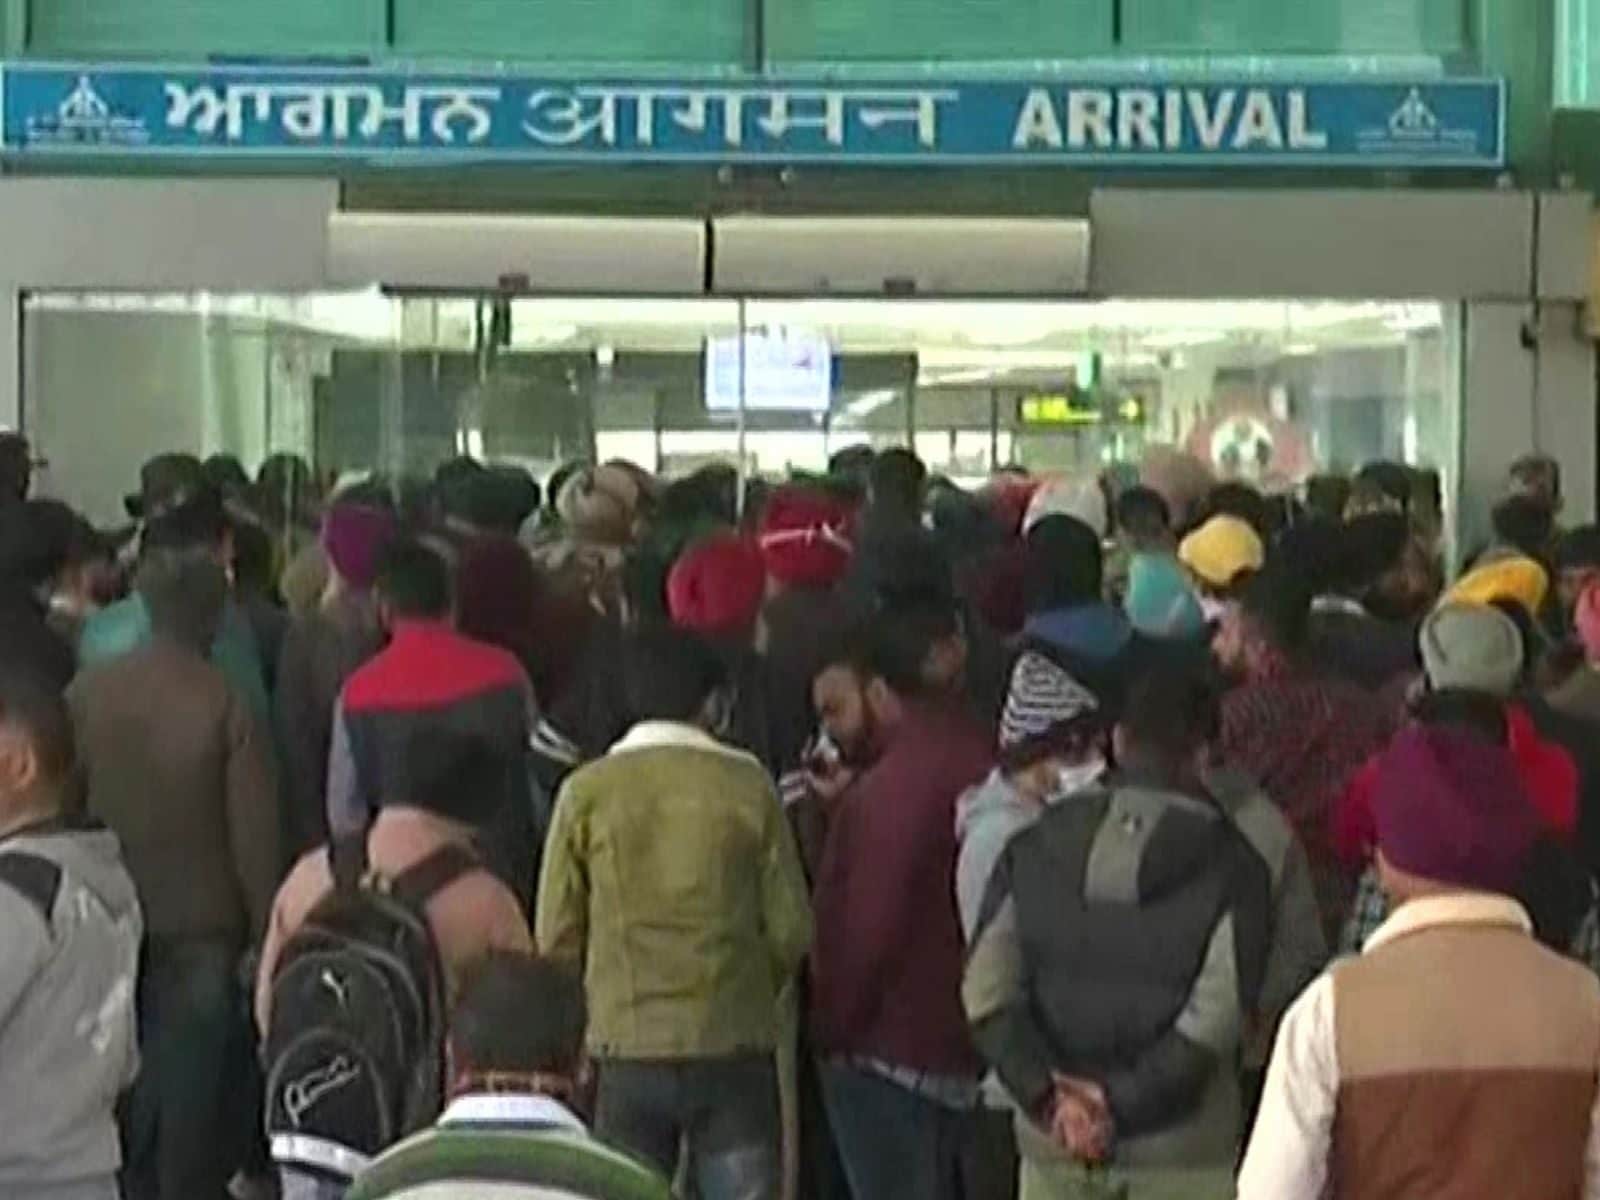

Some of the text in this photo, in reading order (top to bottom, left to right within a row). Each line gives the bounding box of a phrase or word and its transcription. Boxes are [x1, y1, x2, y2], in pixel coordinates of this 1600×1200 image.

[164, 82, 500, 144] ਆਗਮਨ
[522, 86, 960, 147] आगमन
[1012, 88, 1328, 150] ARRIVAL
